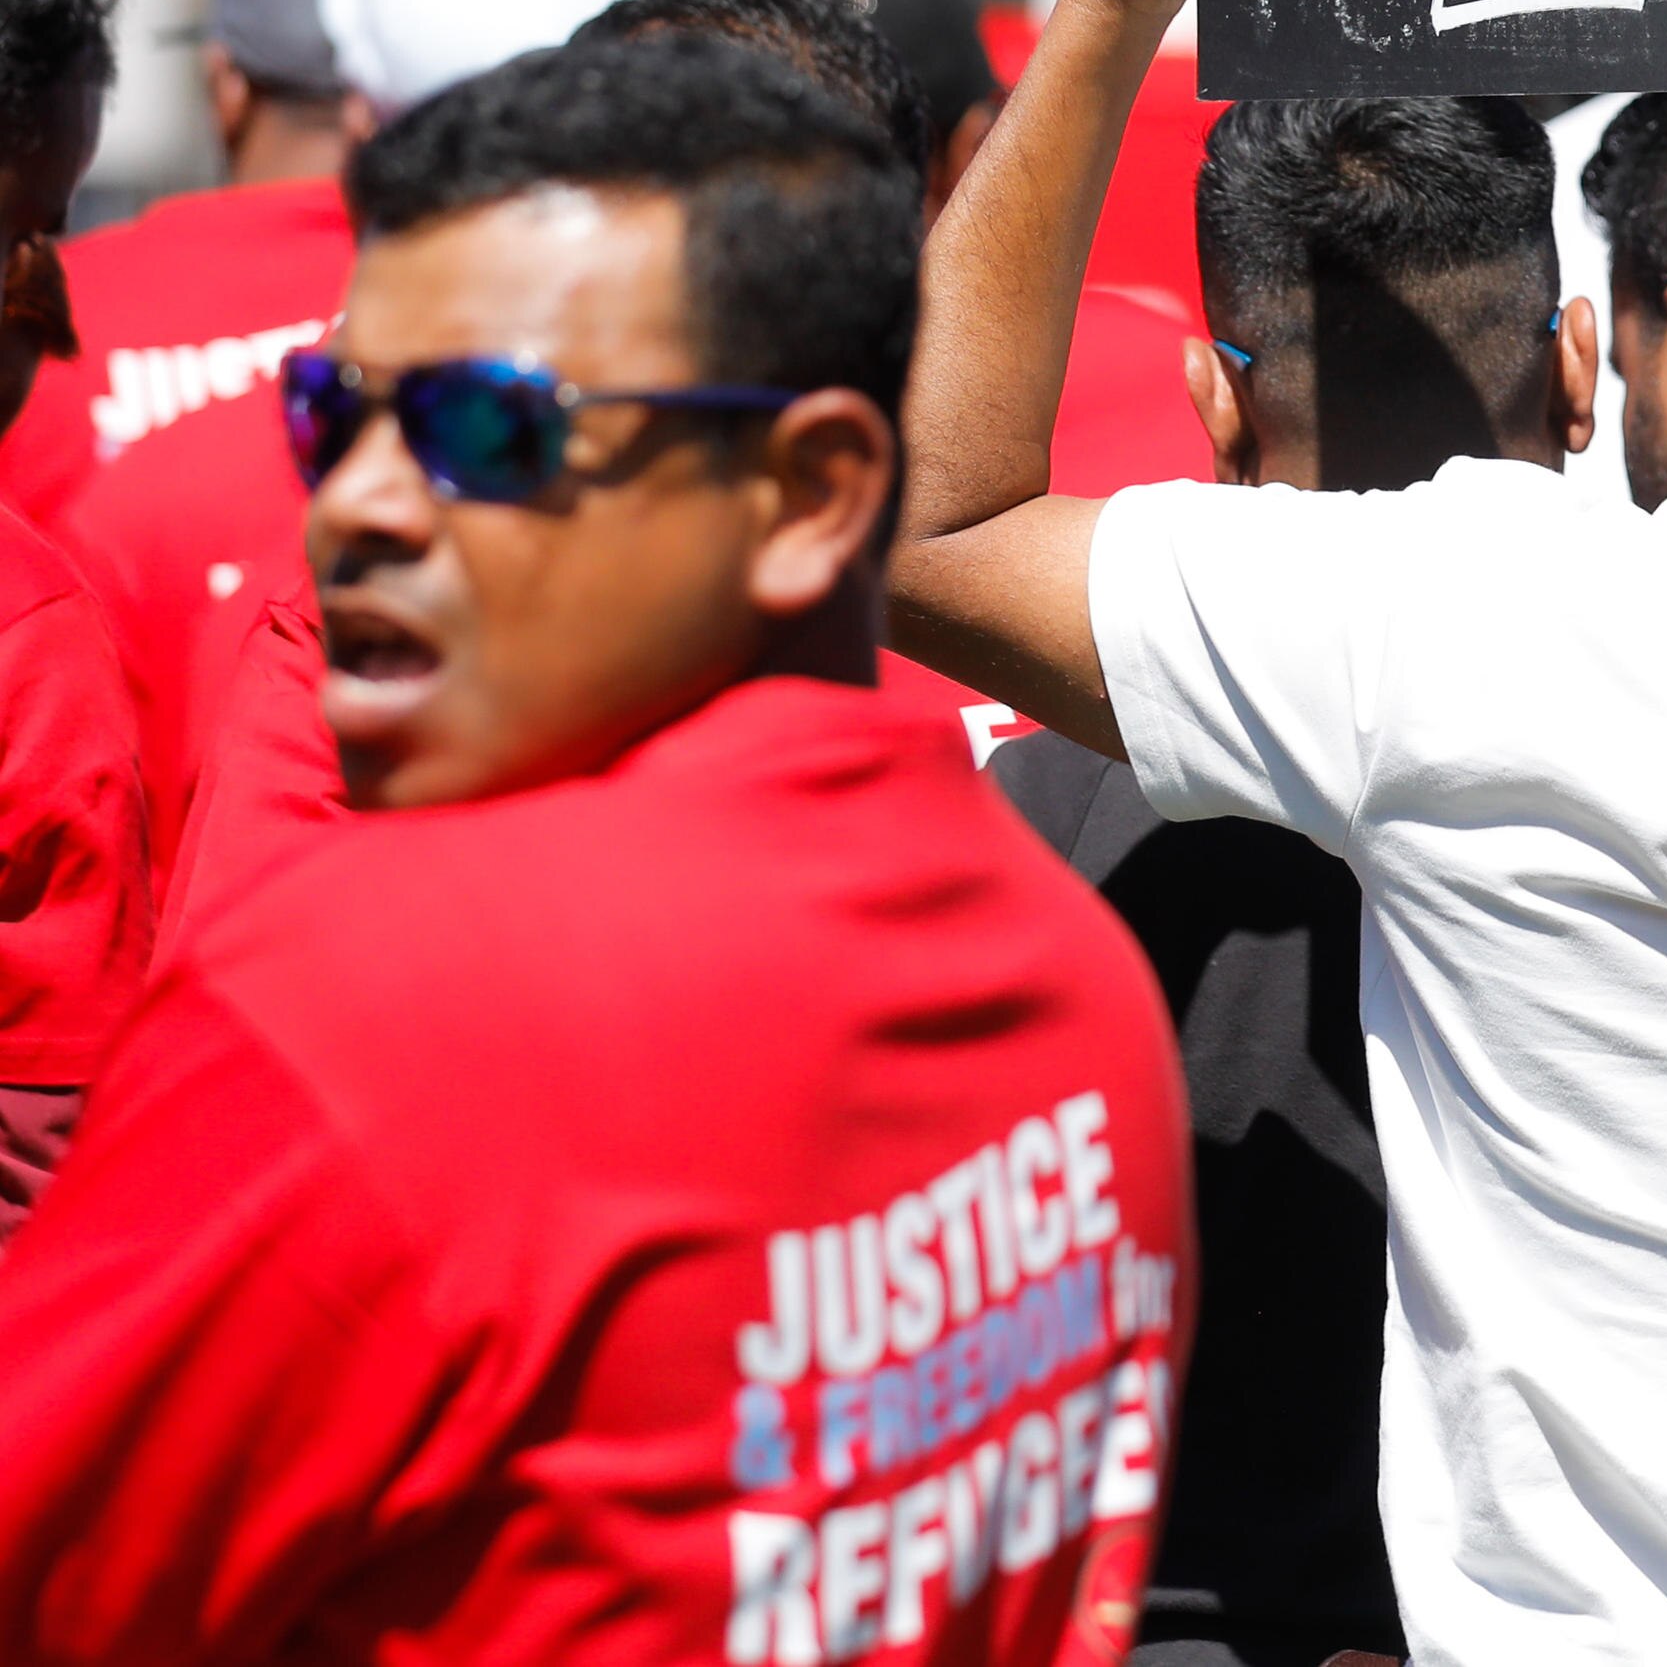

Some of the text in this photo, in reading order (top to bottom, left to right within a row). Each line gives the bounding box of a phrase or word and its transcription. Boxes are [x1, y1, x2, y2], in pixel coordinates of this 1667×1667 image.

[731, 1382, 797, 1491] &
[818, 1251, 1104, 1489] FREEDOM
[737, 1089, 1120, 1385] JUSTICE
